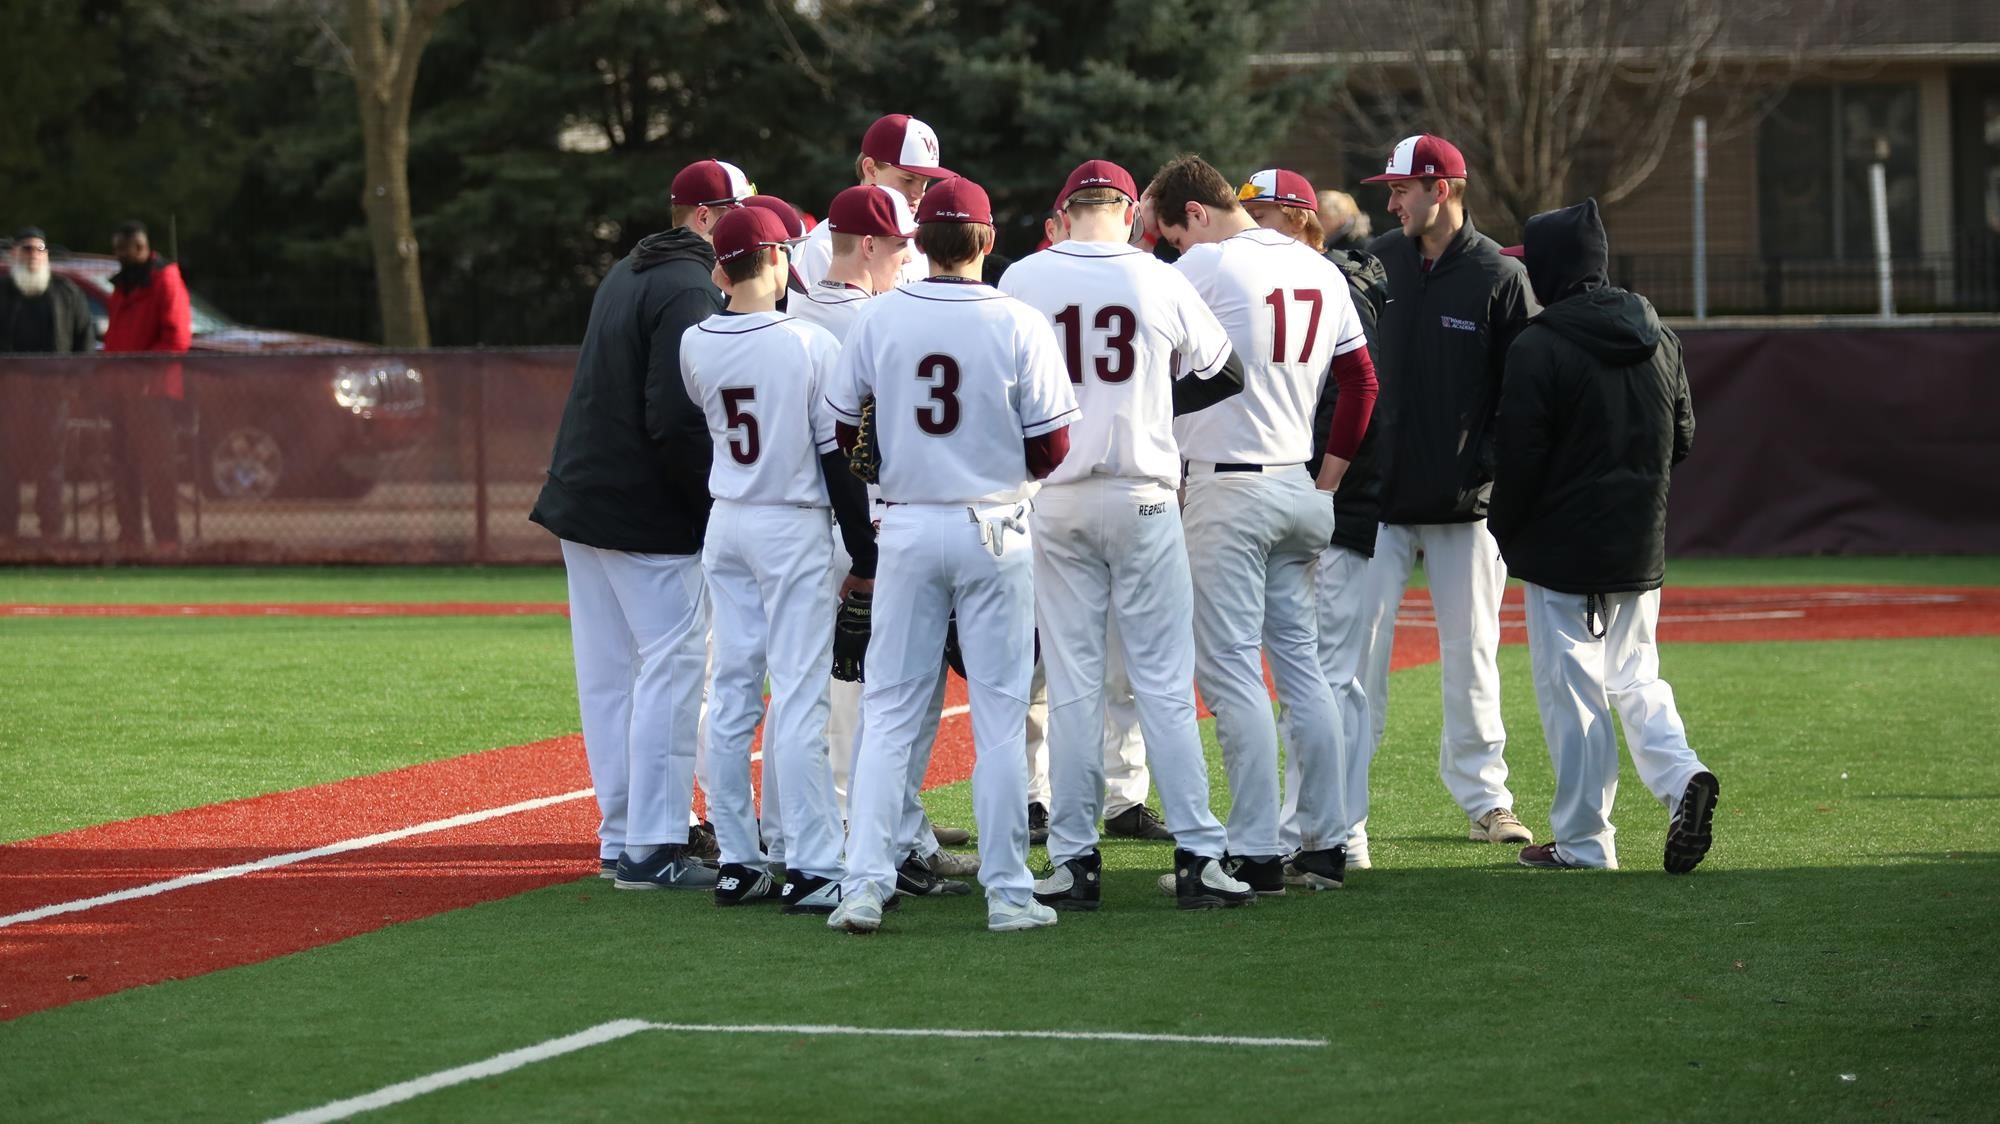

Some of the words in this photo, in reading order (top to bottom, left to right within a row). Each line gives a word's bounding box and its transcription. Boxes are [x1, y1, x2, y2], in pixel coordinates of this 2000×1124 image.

[1053, 303, 1138, 386] 13
[1263, 286, 1323, 366] 17
[718, 385, 761, 467] 5
[914, 352, 963, 438] 3
